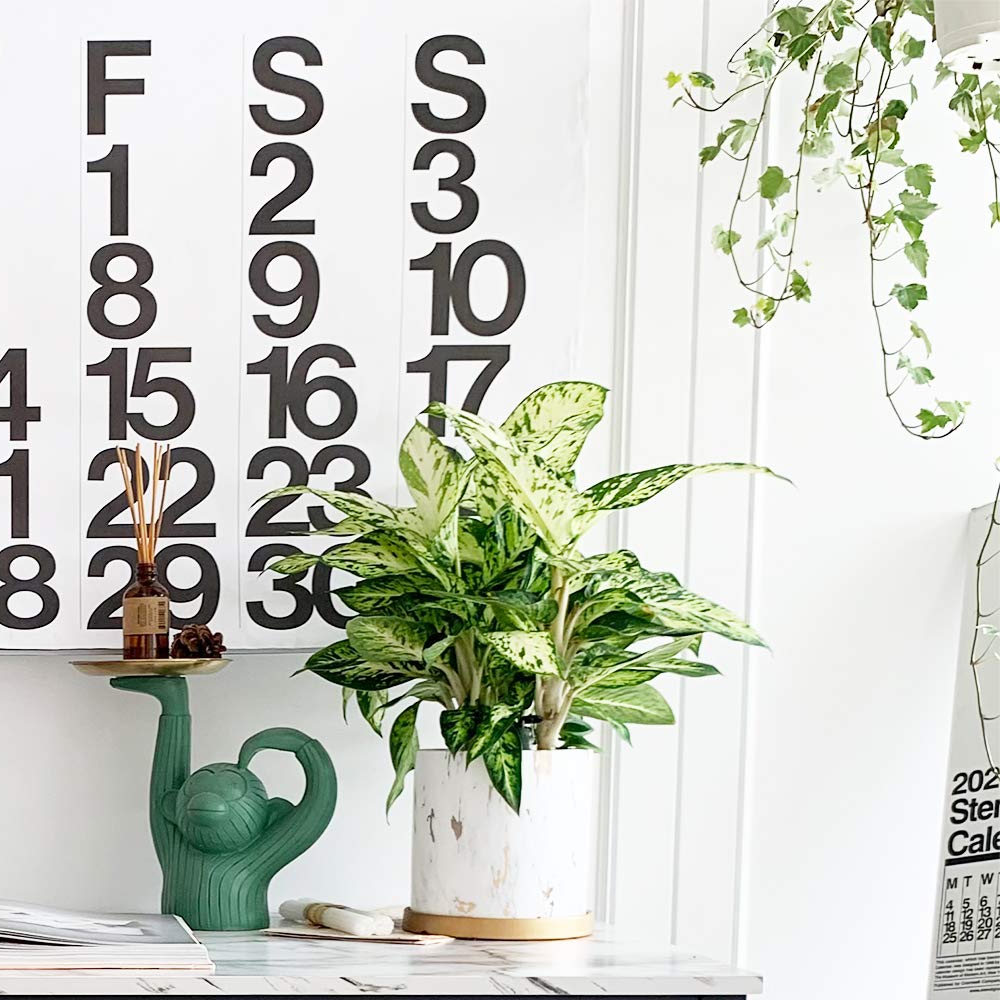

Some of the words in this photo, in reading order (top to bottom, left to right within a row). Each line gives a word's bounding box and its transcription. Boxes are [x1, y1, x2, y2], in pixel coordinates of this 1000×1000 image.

[87, 40, 151, 135] F
[249, 36, 324, 135] S
[411, 35, 486, 134] S
[87, 145, 128, 236] 1
[249, 142, 315, 235] 2
[411, 139, 479, 234] 3
[87, 243, 157, 339] 8
[249, 241, 320, 338] 9
[410, 240, 526, 336] 10
[86, 347, 195, 441] 15
[247, 344, 357, 440] 16
[407, 345, 510, 437] 17
[86, 447, 216, 538] 22
[246, 445, 372, 537] 23
[87, 544, 221, 631] 29
[944, 910, 954, 921] 11
[960, 908, 974, 919] 12
[978, 906, 991, 918] 13
[945, 900, 953, 910] 4
[962, 898, 971, 909] 5
[980, 895, 988, 907] 6
[946, 877, 958, 889] M
[963, 875, 973, 887] T
[981, 872, 994, 885] W
[942, 932, 957, 944] 25
[959, 930, 974, 942] 26
[976, 928, 992, 940] 27
[943, 921, 956, 932] 18
[960, 919, 973, 931] 19
[977, 917, 993, 929] 20
